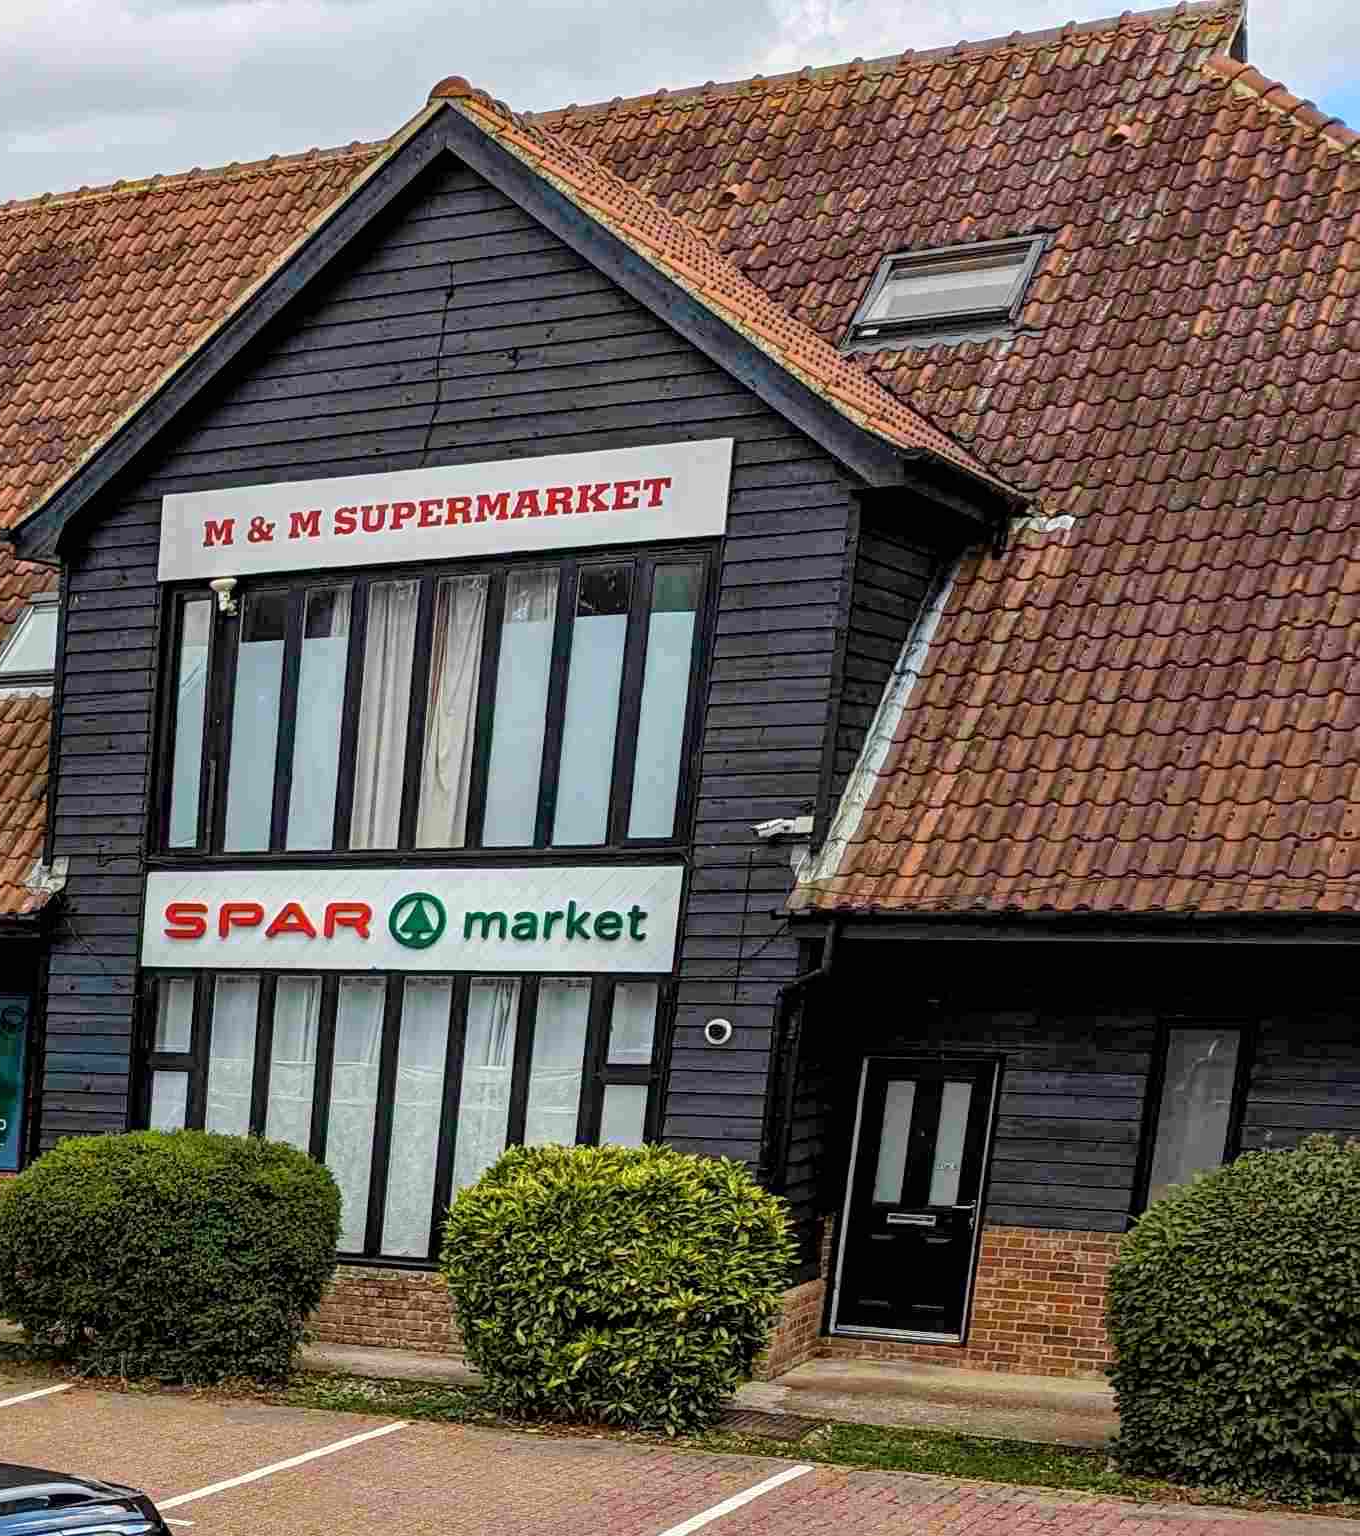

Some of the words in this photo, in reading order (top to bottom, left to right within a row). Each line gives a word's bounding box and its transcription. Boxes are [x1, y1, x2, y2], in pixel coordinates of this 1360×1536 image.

[202, 518, 235, 548] M
[247, 516, 275, 543] &
[288, 510, 322, 539] M
[334, 477, 672, 536] SUPERMARKET
[163, 901, 374, 940] SPAR
[462, 900, 649, 941] market
